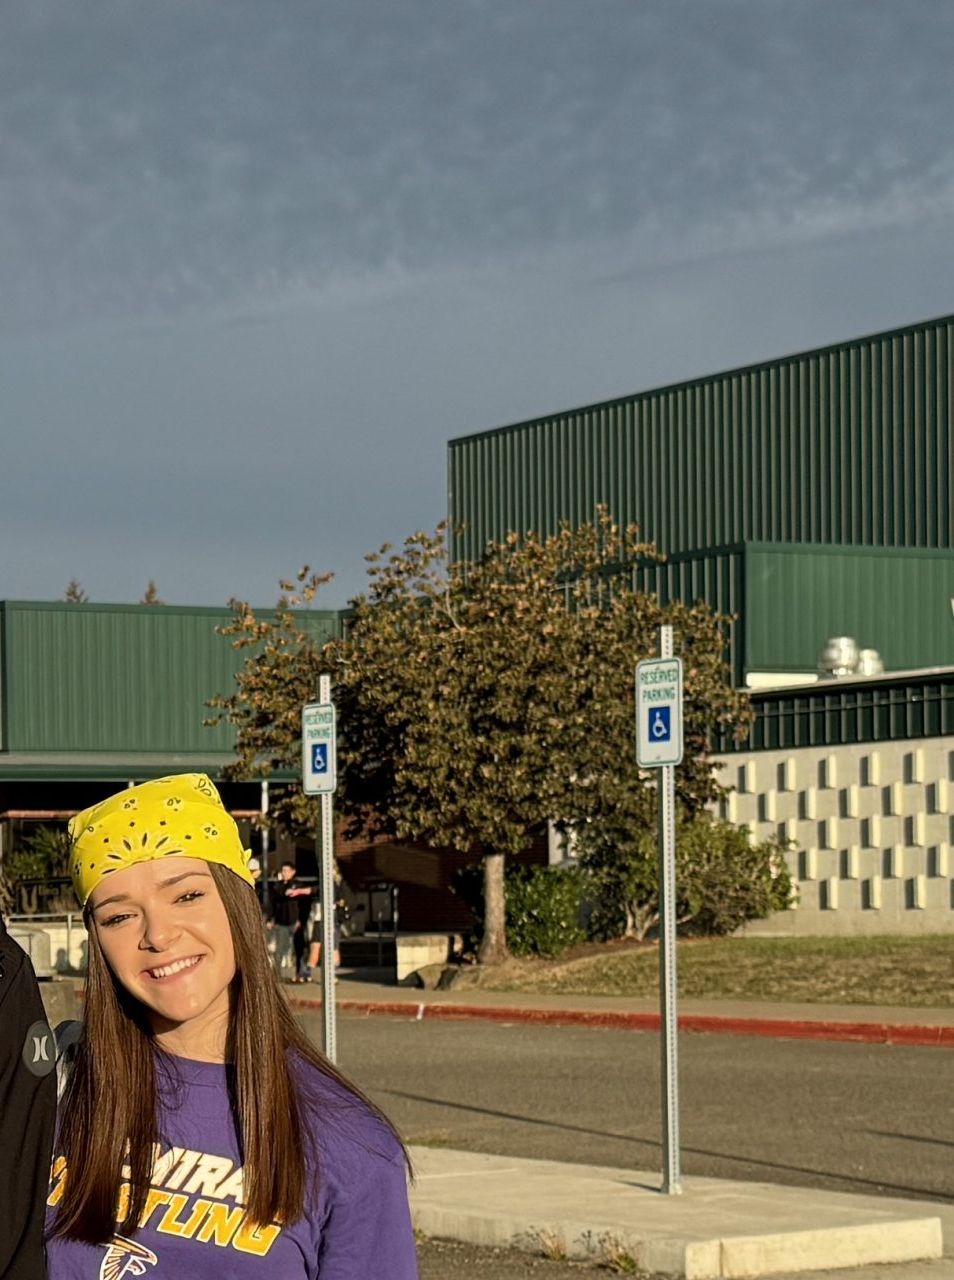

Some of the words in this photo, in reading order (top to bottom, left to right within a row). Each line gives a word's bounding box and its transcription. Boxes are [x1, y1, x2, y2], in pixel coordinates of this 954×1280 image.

[640, 669, 678, 685] RESERVED
[643, 687, 675, 702] PARKING
[305, 712, 333, 725] RESERVED
[307, 727, 331, 739] PARKING
